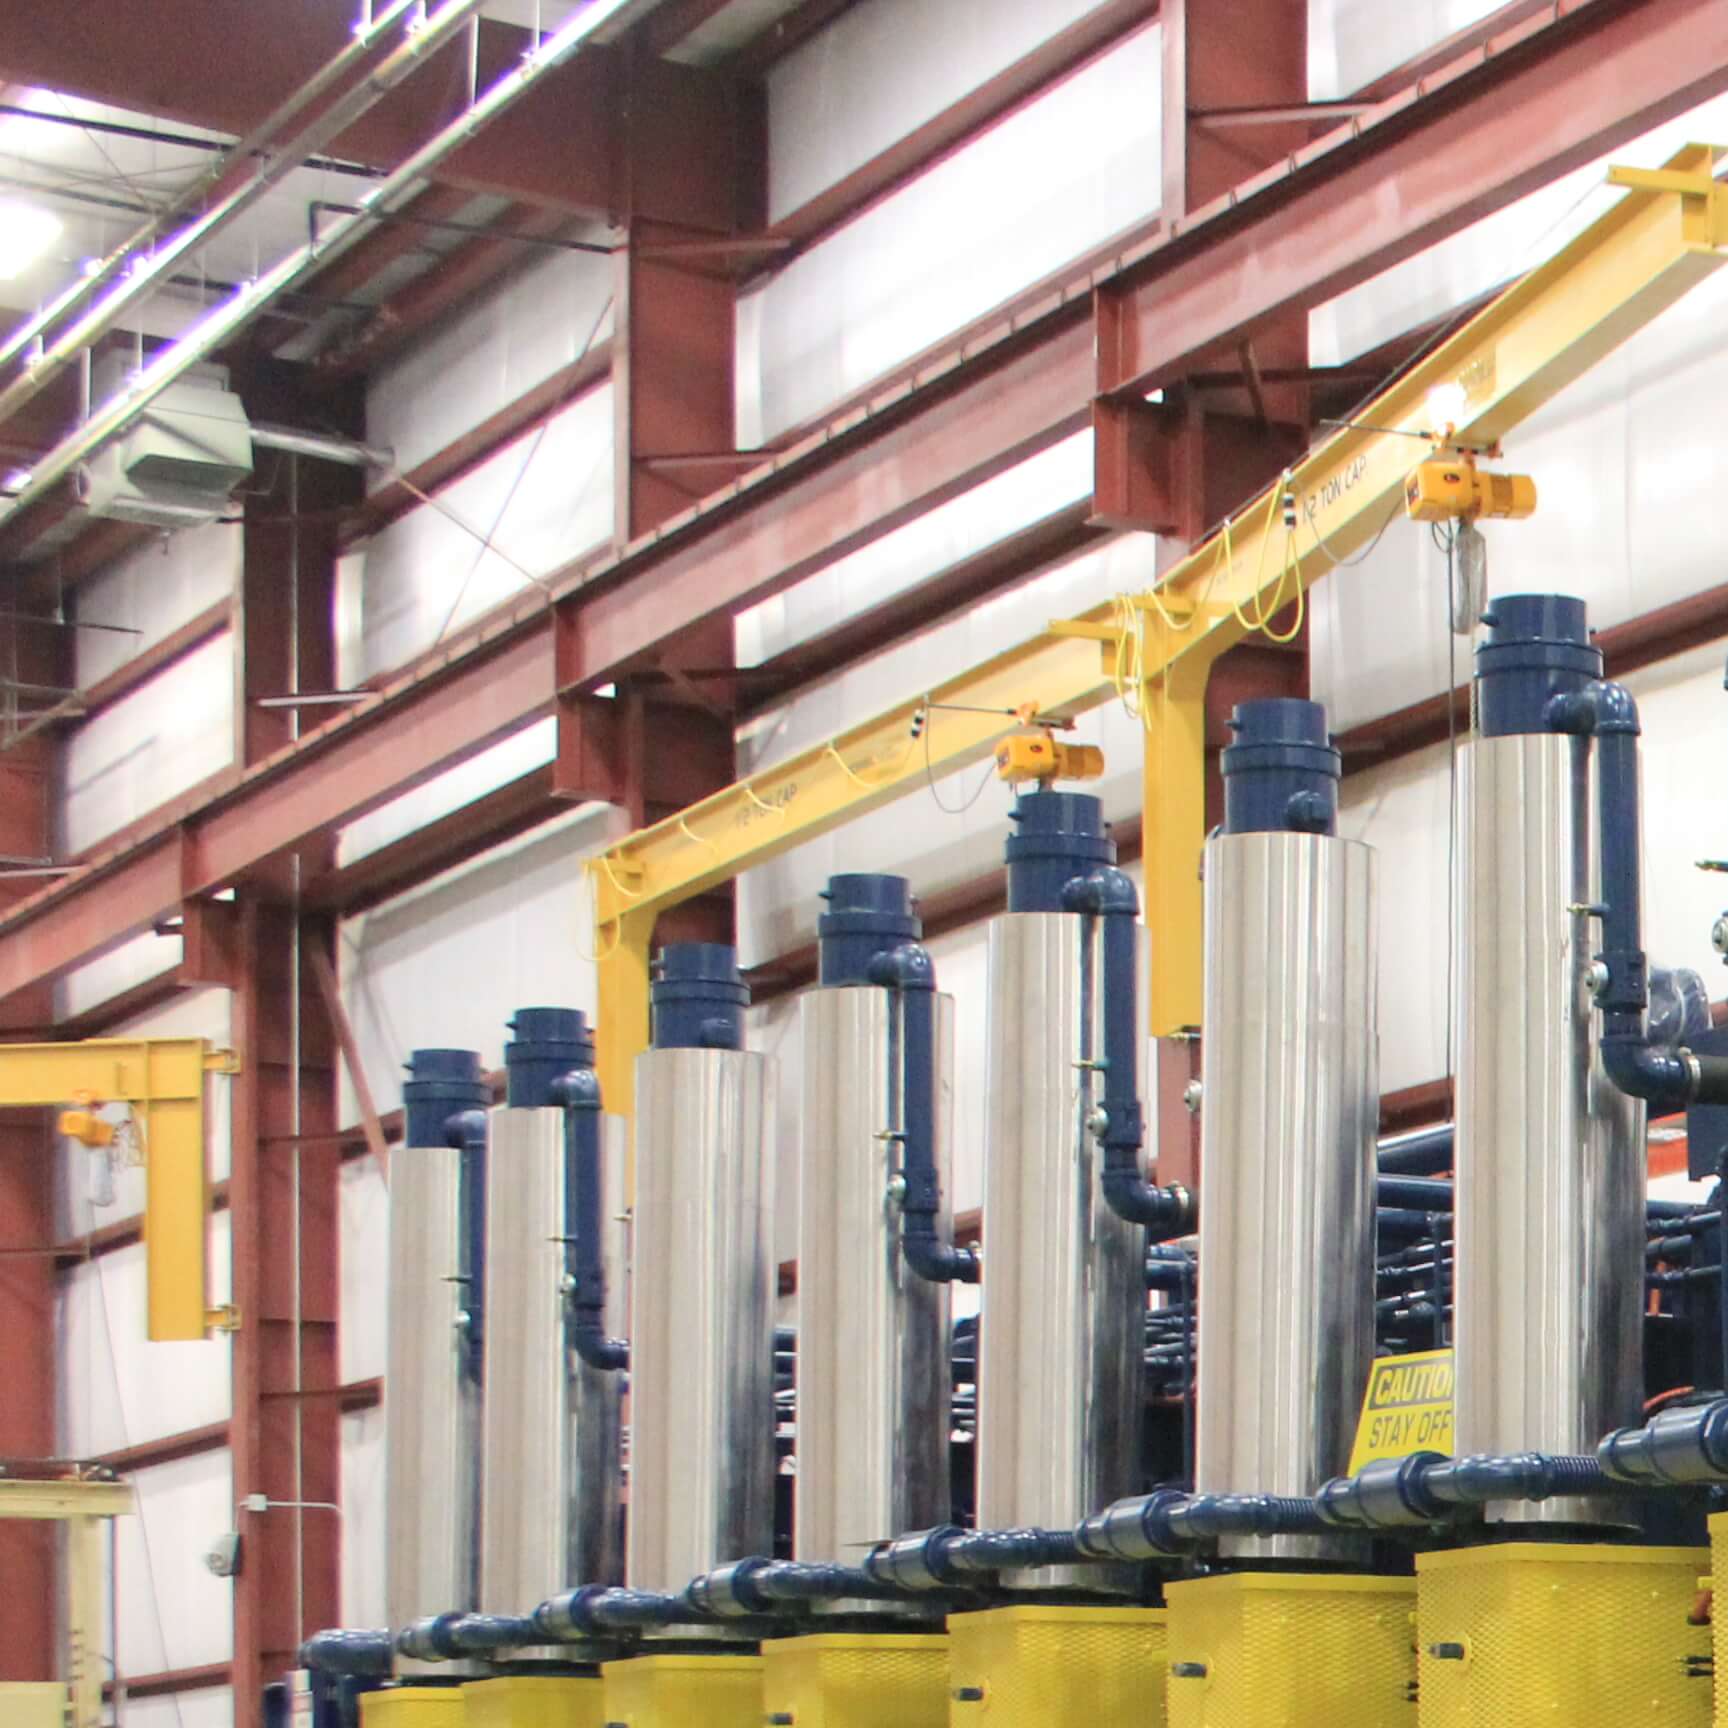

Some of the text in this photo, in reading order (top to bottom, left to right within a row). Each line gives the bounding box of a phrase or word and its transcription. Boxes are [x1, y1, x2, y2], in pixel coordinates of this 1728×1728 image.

[1375, 1363, 1453, 1405] CAUTIO
[1369, 1409, 1452, 1449] STAY OFF
